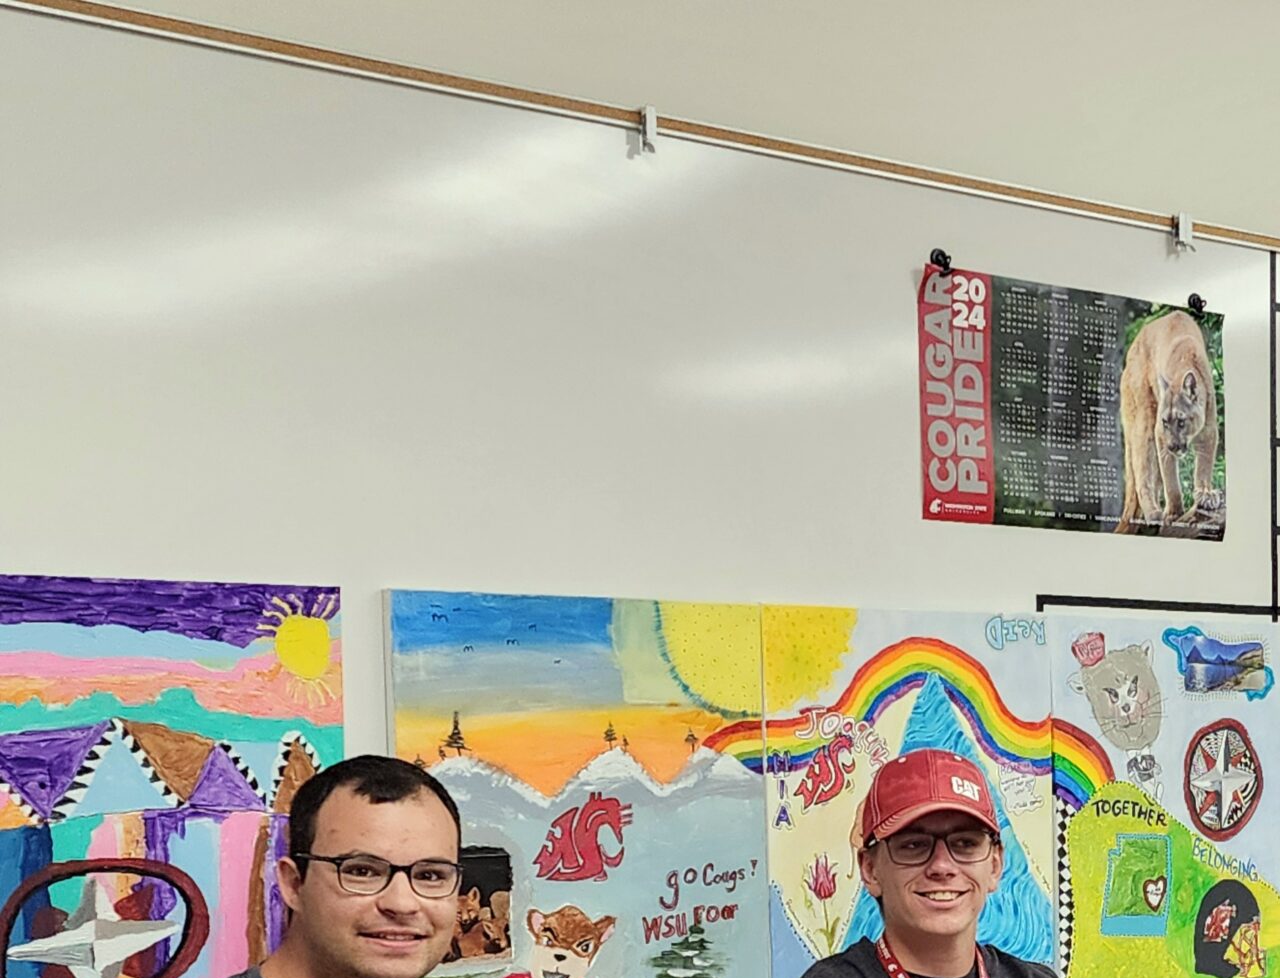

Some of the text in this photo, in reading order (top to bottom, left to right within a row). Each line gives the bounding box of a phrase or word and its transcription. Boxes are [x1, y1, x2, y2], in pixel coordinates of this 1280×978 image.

[952, 275, 986, 304] 20
[952, 302, 986, 331] 24
[924, 272, 956, 493] COUGAR
[953, 328, 988, 494] PRIDE
[951, 776, 980, 802] CAT
[1091, 799, 1167, 827] TOGETHER
[1192, 836, 1259, 882] BELONGING
[659, 868, 698, 911] go
[641, 912, 688, 945] WSU
